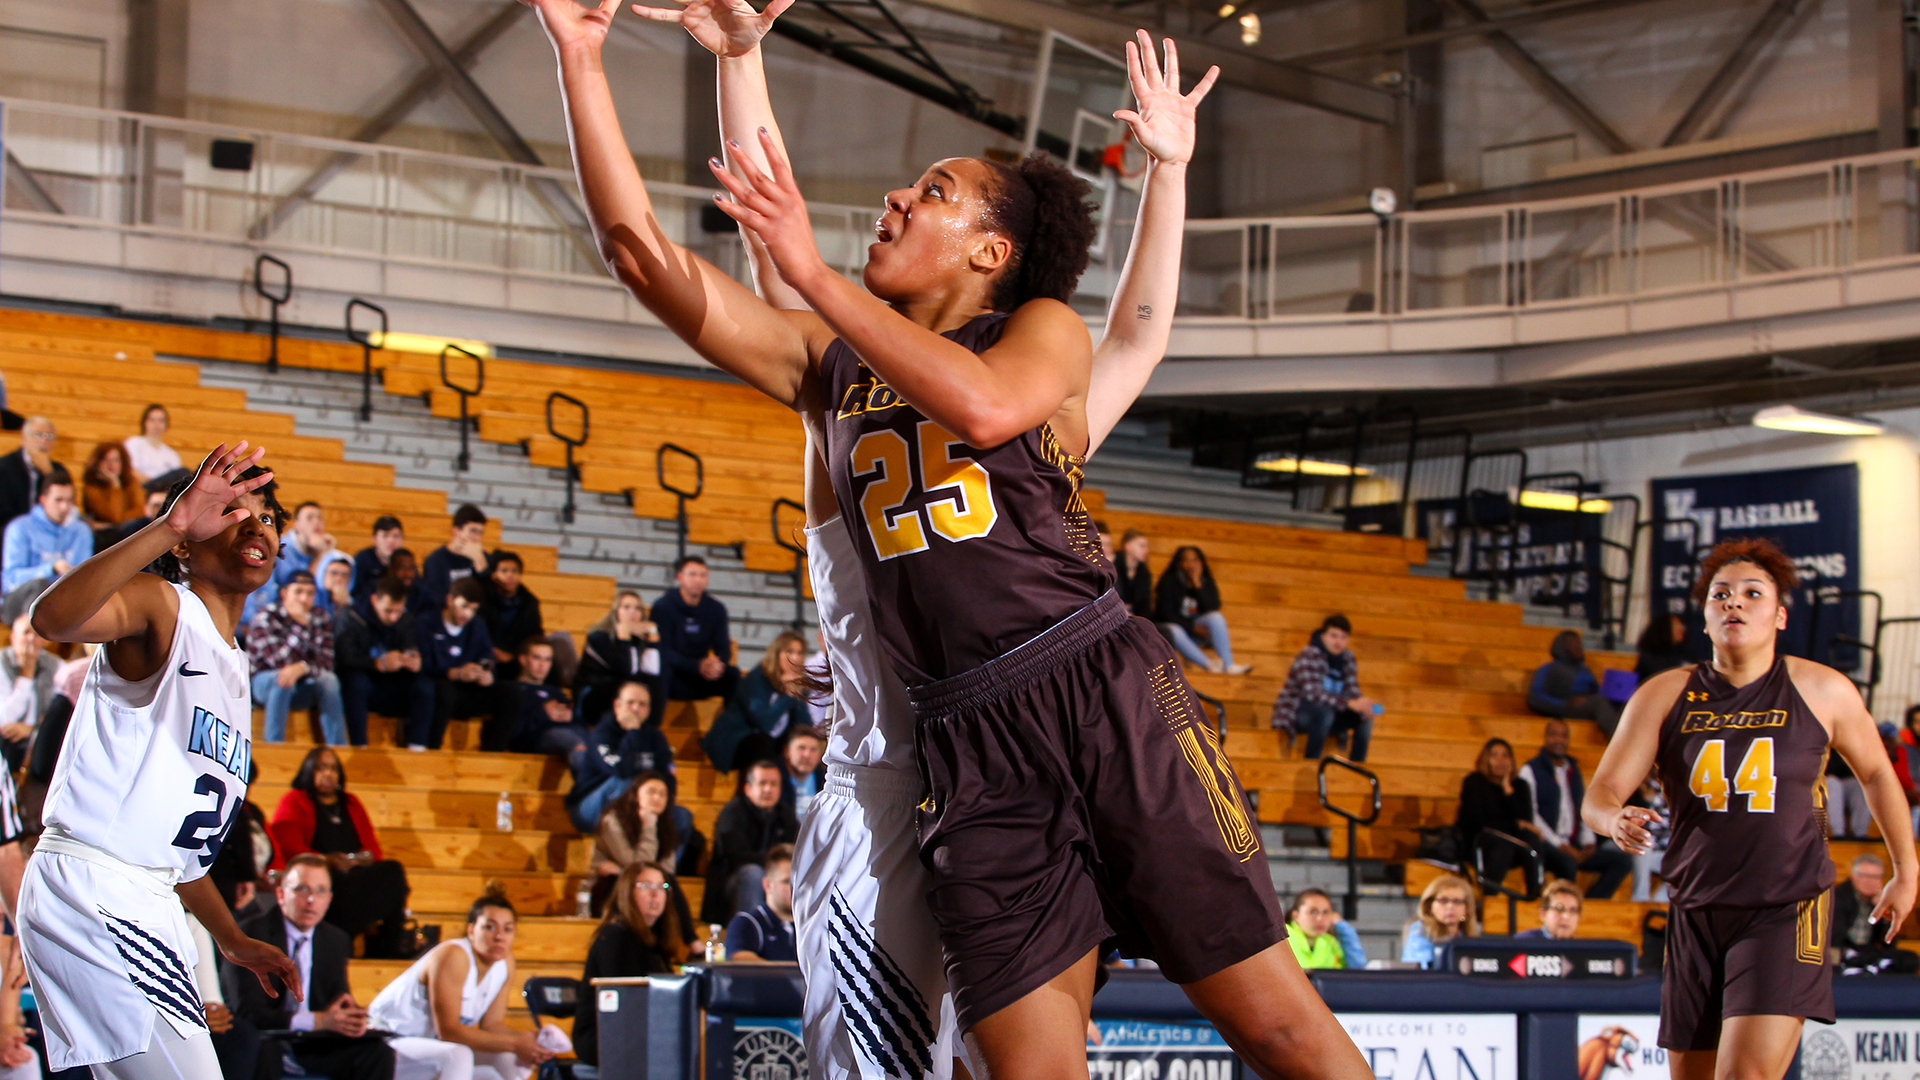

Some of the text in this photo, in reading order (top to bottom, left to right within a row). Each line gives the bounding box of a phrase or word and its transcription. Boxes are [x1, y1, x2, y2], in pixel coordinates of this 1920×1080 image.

[850, 419, 998, 561] 25
[1719, 499, 1820, 530] BASEBALL
[1681, 709, 1788, 733] Rowan
[1688, 736, 1777, 813] 44
[1526, 955, 1562, 977] POSS
[1109, 1027, 1192, 1042] ATHLETICS
[1350, 1023, 1468, 1036] WELCOME TO
[1856, 1032, 1907, 1062] KEAN
